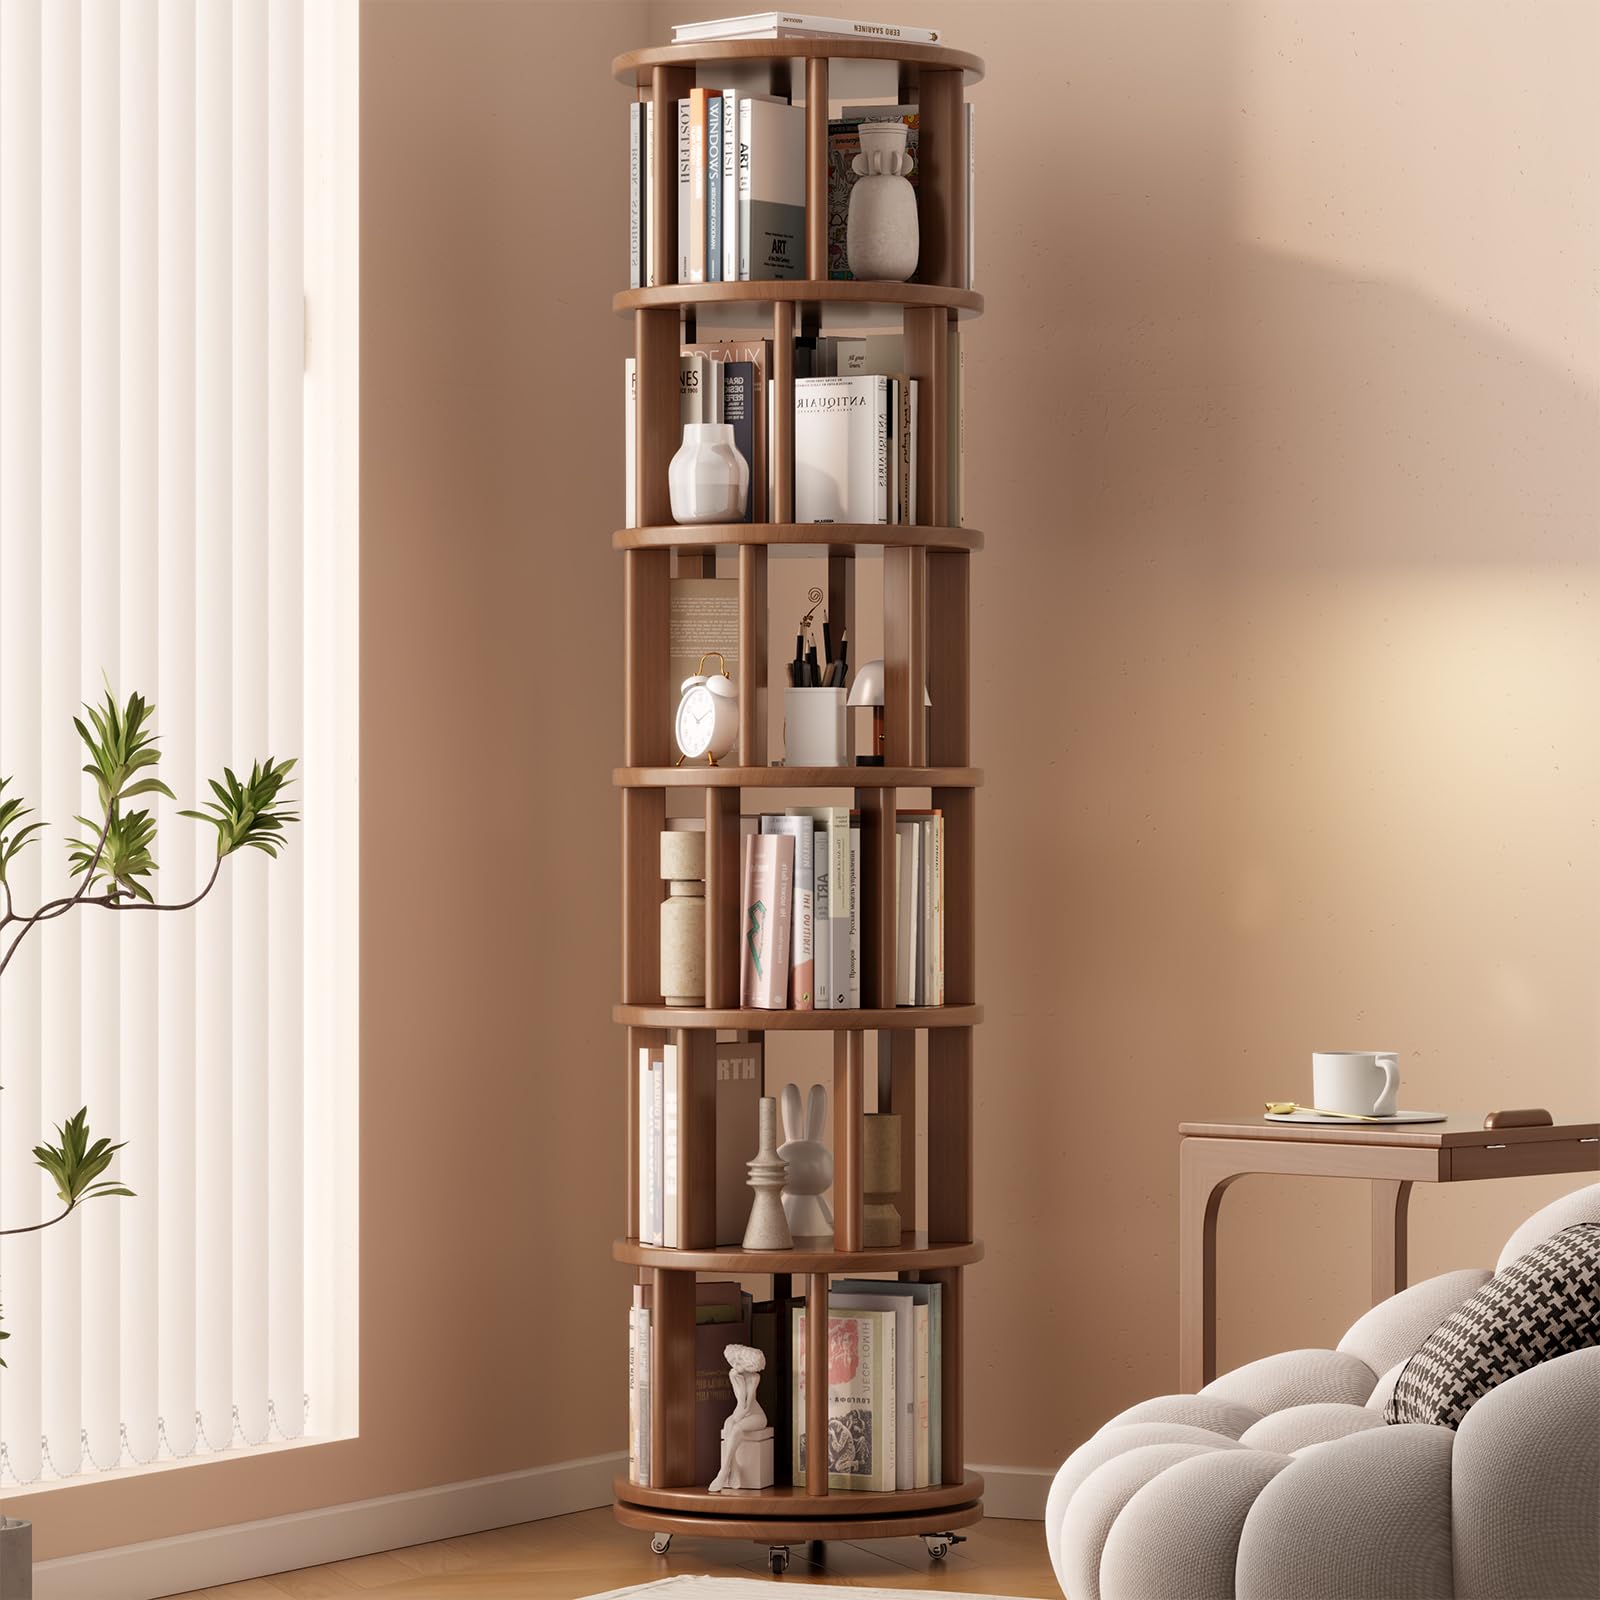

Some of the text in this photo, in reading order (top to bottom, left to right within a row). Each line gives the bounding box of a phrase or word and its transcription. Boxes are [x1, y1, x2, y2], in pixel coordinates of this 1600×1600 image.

[854, 25, 900, 37] EERO SAARINEN
[681, 104, 690, 183] LOST FISH
[709, 103, 719, 179] WINDOWS
[725, 95, 733, 177] LOST FISH
[740, 143, 749, 170] ART
[771, 238, 787, 255] ART
[849, 849, 857, 888] управления
[803, 914, 812, 955] OUTSIDERS
[849, 910, 857, 935] Русская
[849, 950, 857, 979] Прохоров
[717, 1058, 755, 1080] RTH
